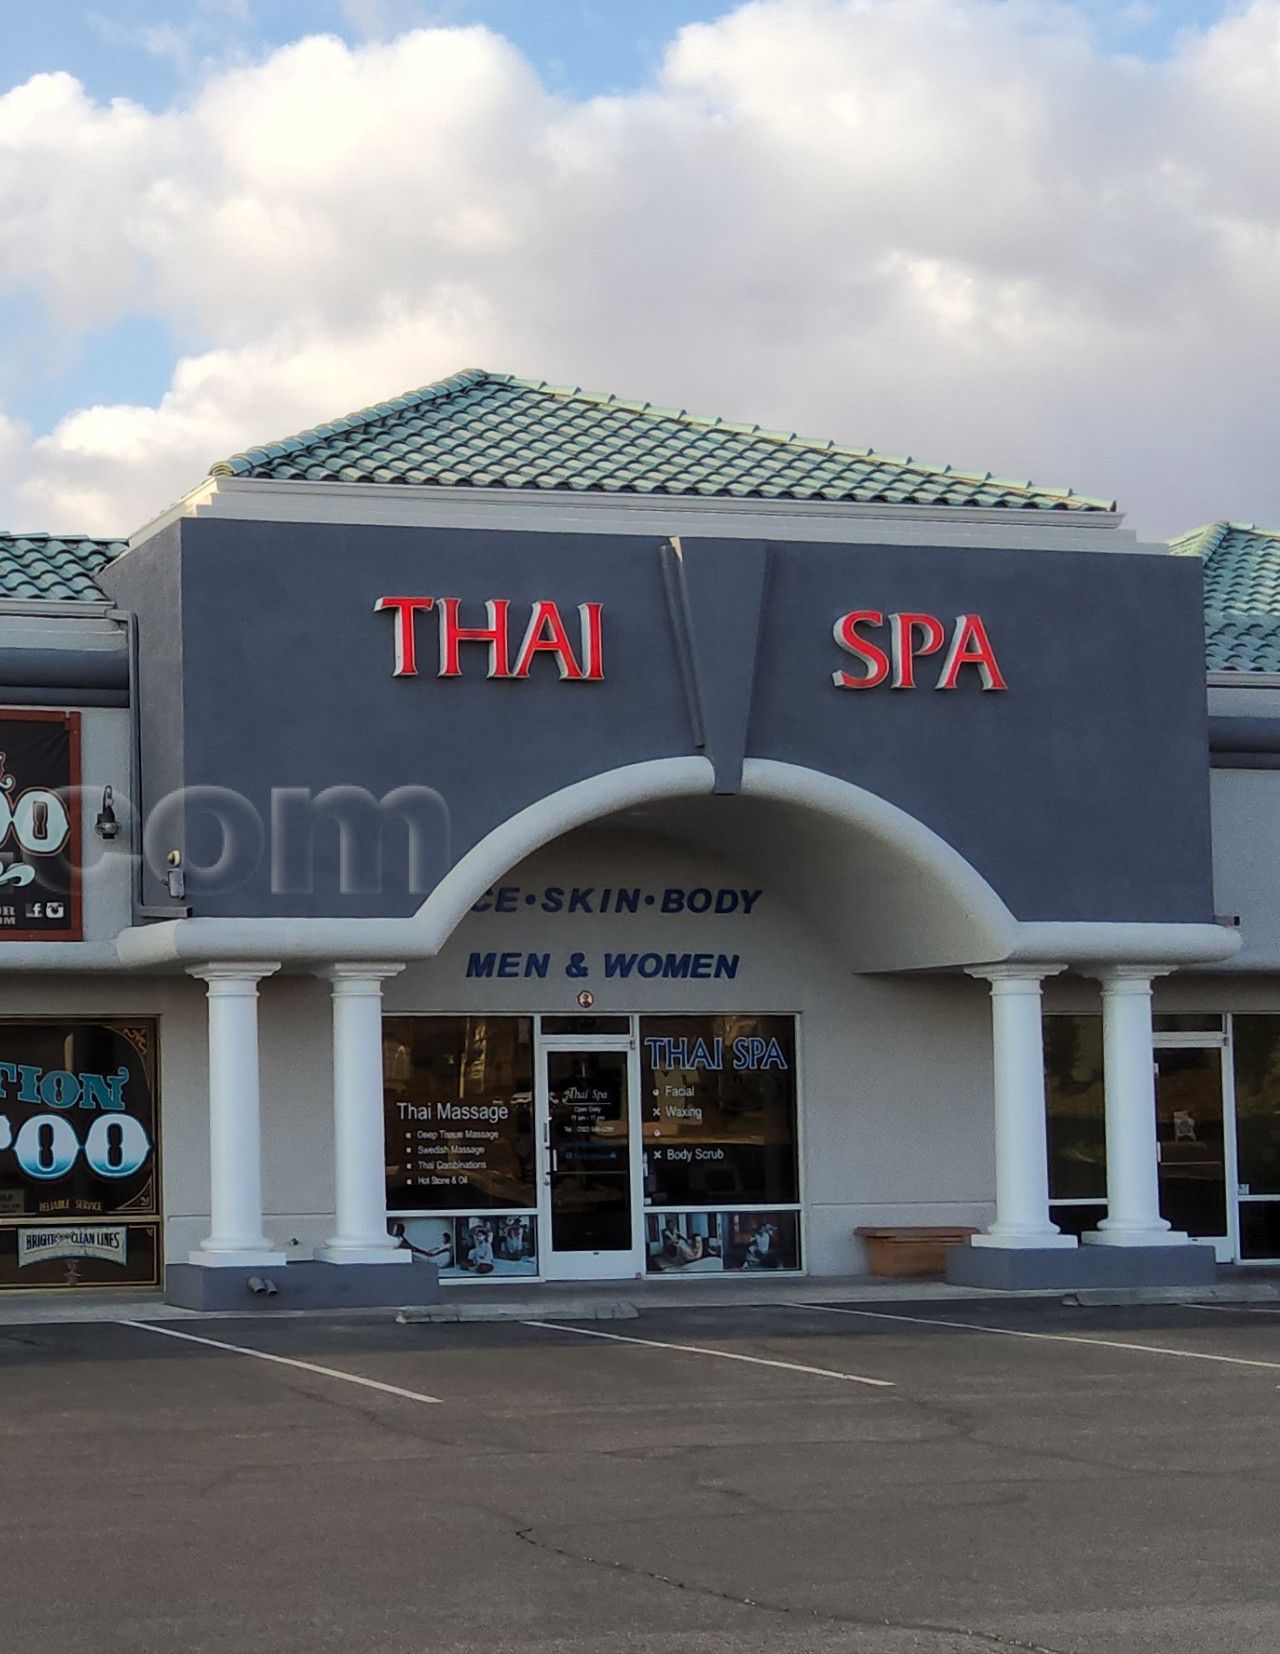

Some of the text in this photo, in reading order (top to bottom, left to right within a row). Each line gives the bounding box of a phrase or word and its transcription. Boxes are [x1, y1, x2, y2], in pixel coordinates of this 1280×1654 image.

[373, 596, 1009, 691] THAI SPA
[465, 952, 740, 979] MEN & WOMEN
[644, 1037, 788, 1070] THAI SPA
[567, 1087, 608, 1101] Thai Spa
[665, 1086, 695, 1097] Facial
[396, 1103, 509, 1123] Thai Massage
[665, 1106, 703, 1119] Waxing
[465, 1131, 499, 1141] Massage
[451, 1146, 485, 1156] Massage
[667, 1148, 725, 1162] Body Scrub
